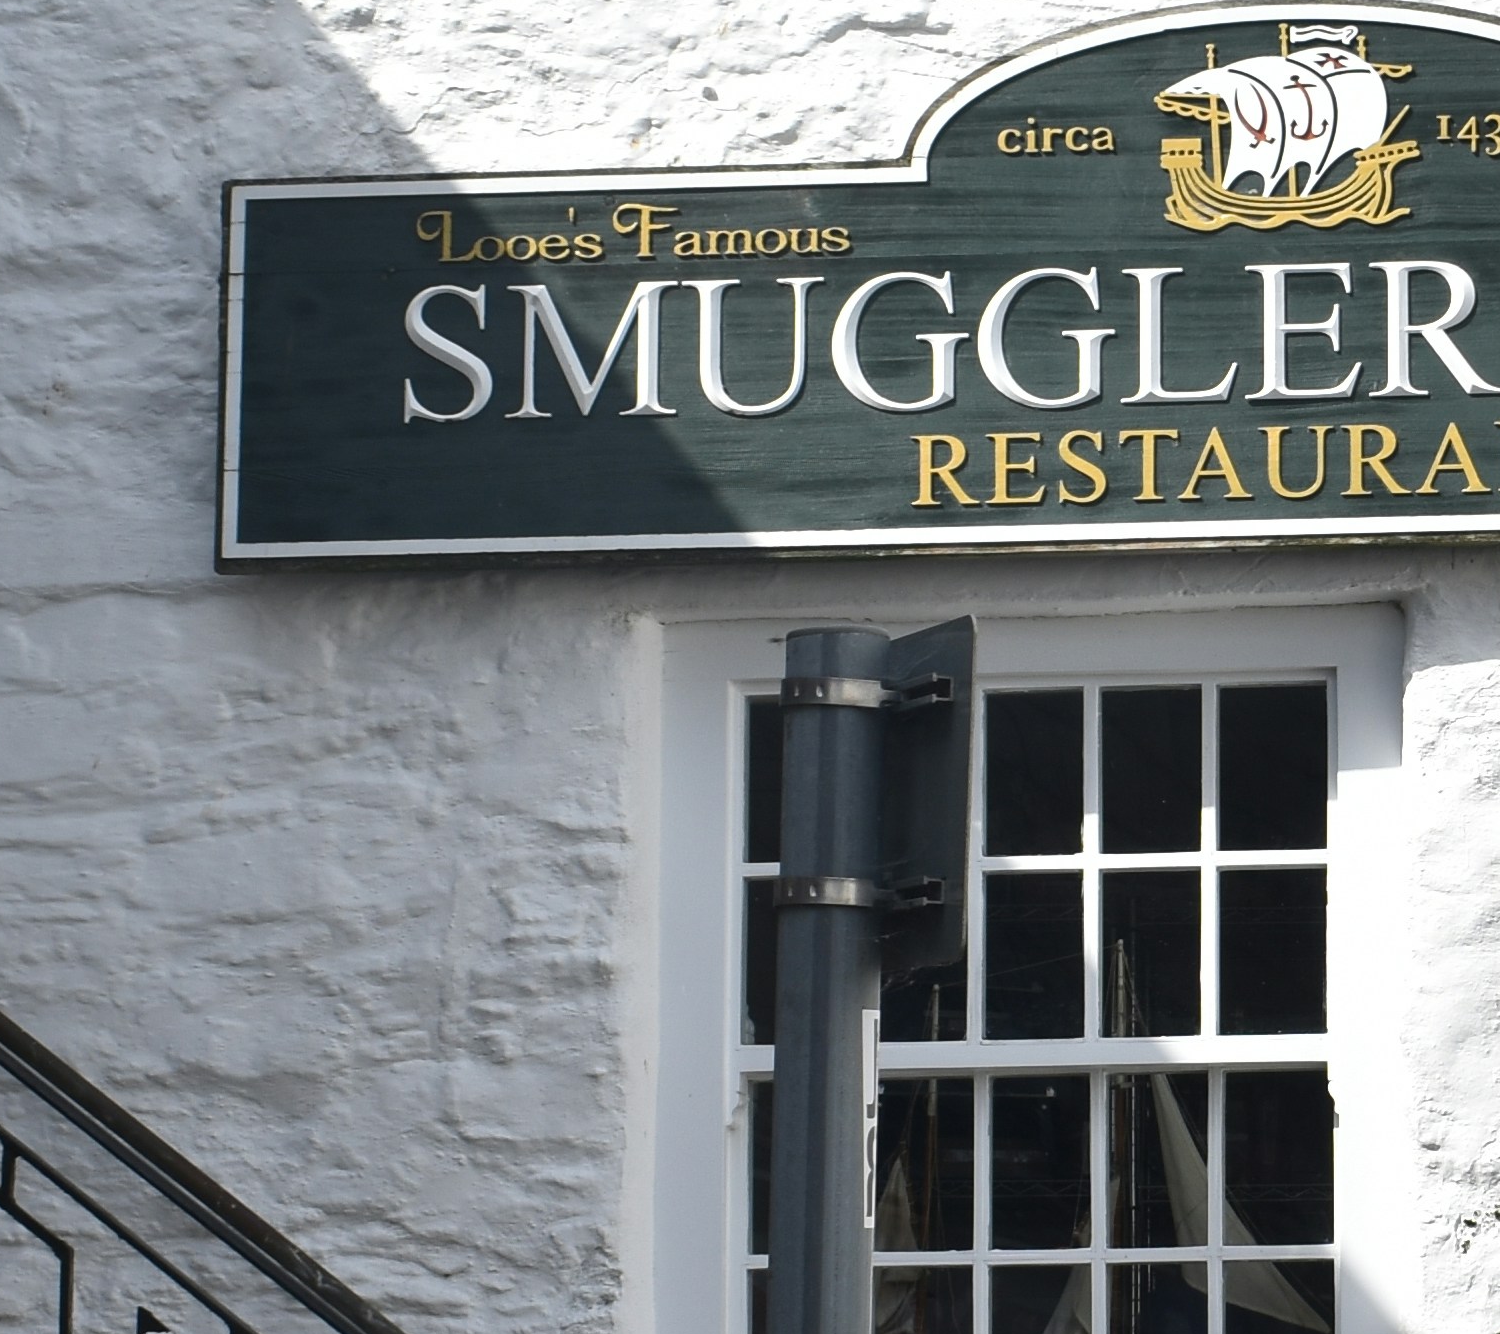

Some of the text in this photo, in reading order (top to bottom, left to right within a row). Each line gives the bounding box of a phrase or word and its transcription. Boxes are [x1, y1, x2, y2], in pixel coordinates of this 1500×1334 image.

[997, 117, 1116, 155] circa
[416, 202, 852, 263] Looe's Famous
